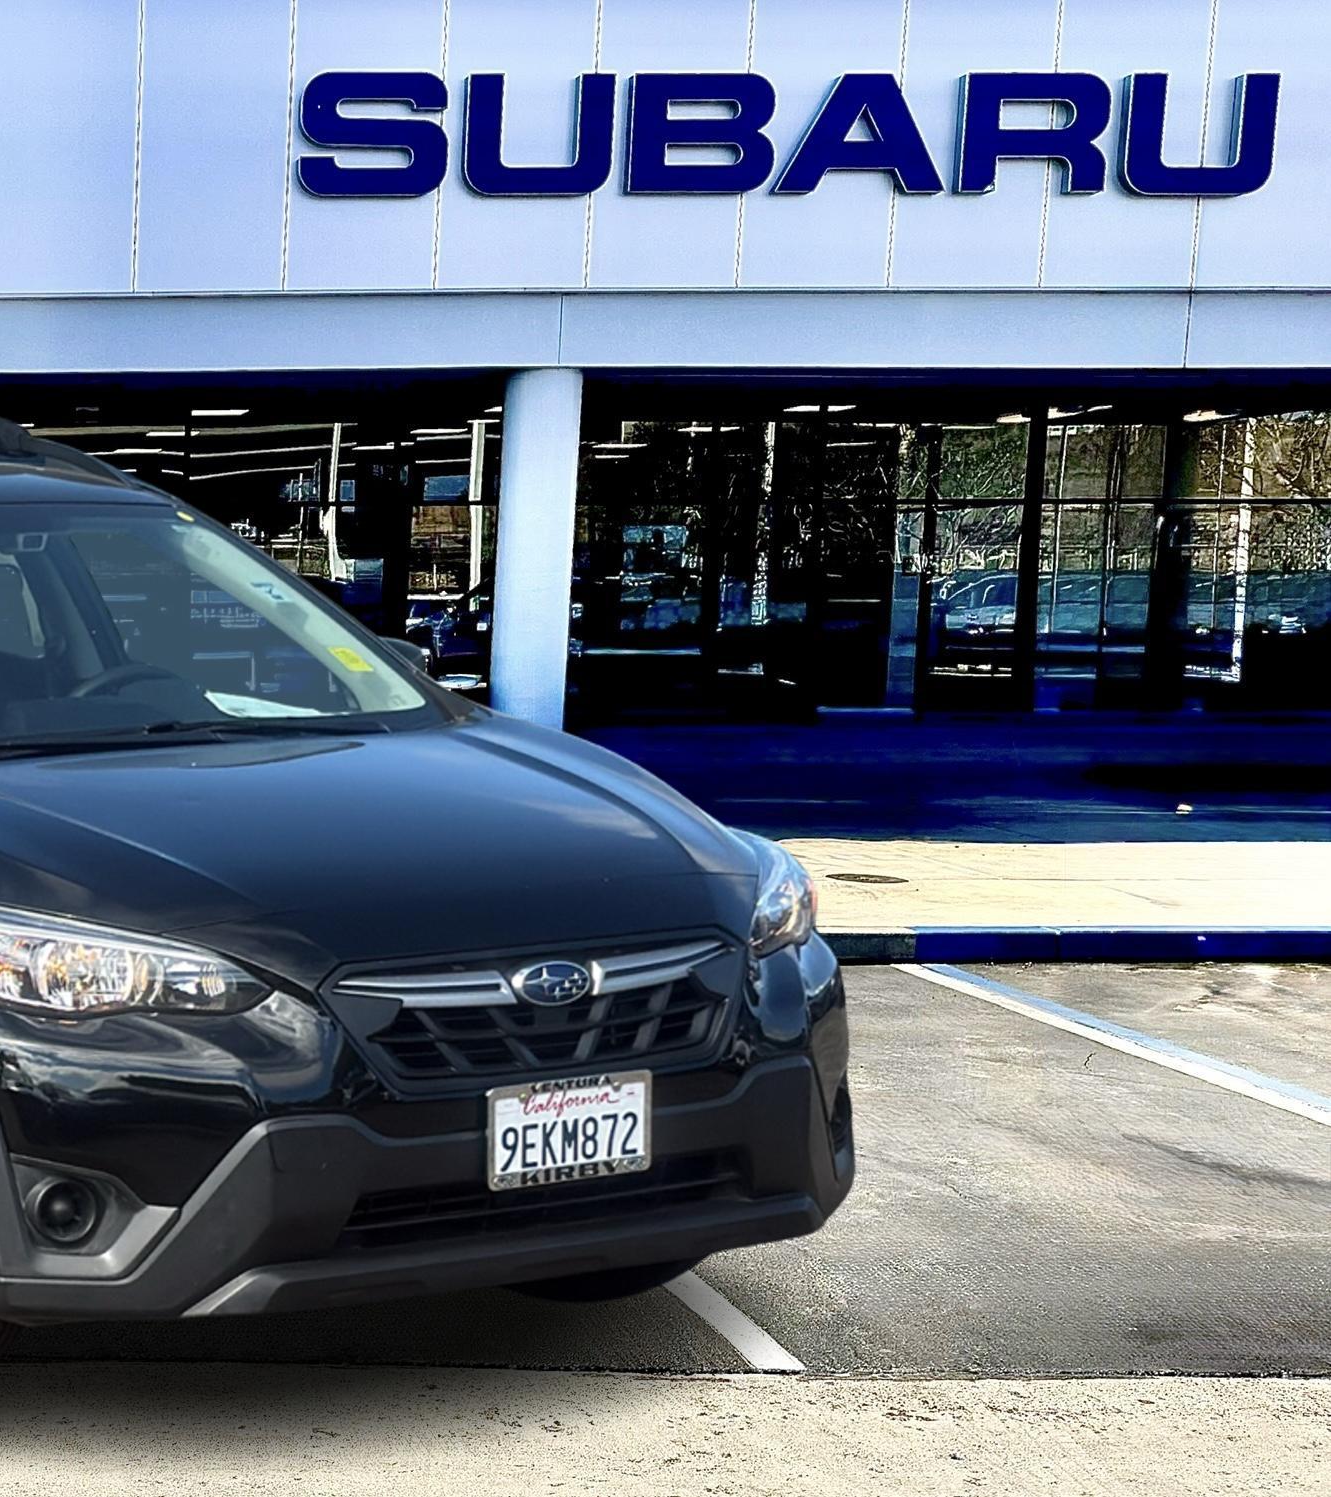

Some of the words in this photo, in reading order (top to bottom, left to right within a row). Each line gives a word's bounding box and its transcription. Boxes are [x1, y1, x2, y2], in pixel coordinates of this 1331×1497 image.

[297, 70, 1282, 199] SUBARU
[531, 1075, 612, 1093] VENTURA
[522, 1089, 620, 1117] California
[501, 1111, 639, 1173] 9EKM872
[521, 1160, 620, 1185] KIRBY
